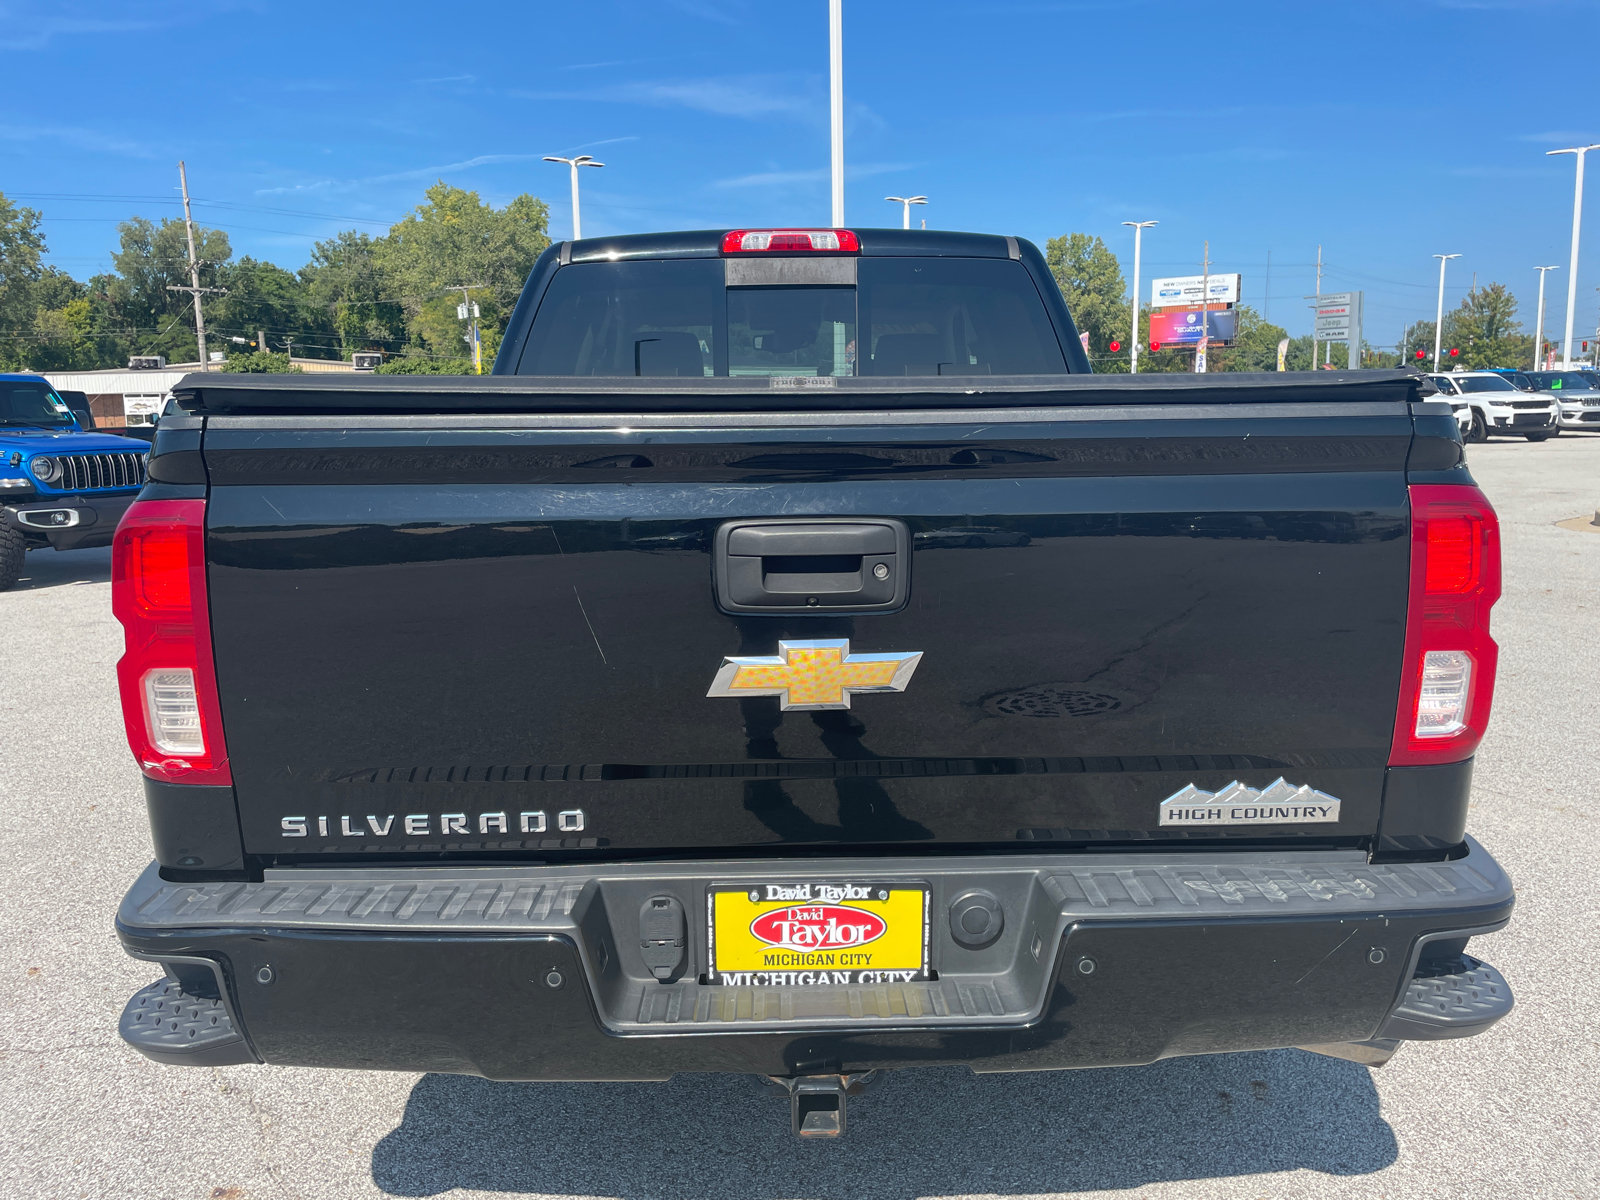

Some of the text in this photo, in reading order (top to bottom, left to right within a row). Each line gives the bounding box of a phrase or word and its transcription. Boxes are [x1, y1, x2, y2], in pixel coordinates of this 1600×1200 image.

[1322, 319, 1341, 327] Jeep
[1168, 806, 1333, 820] HIGH COUNTRY
[281, 809, 586, 837] SILVERADO
[766, 884, 873, 903] David Taylor
[787, 908, 824, 921] David
[770, 918, 872, 951] Taylor
[763, 953, 873, 966] MICHIGAN CITY
[721, 970, 918, 986] MICHIGAN CITY
